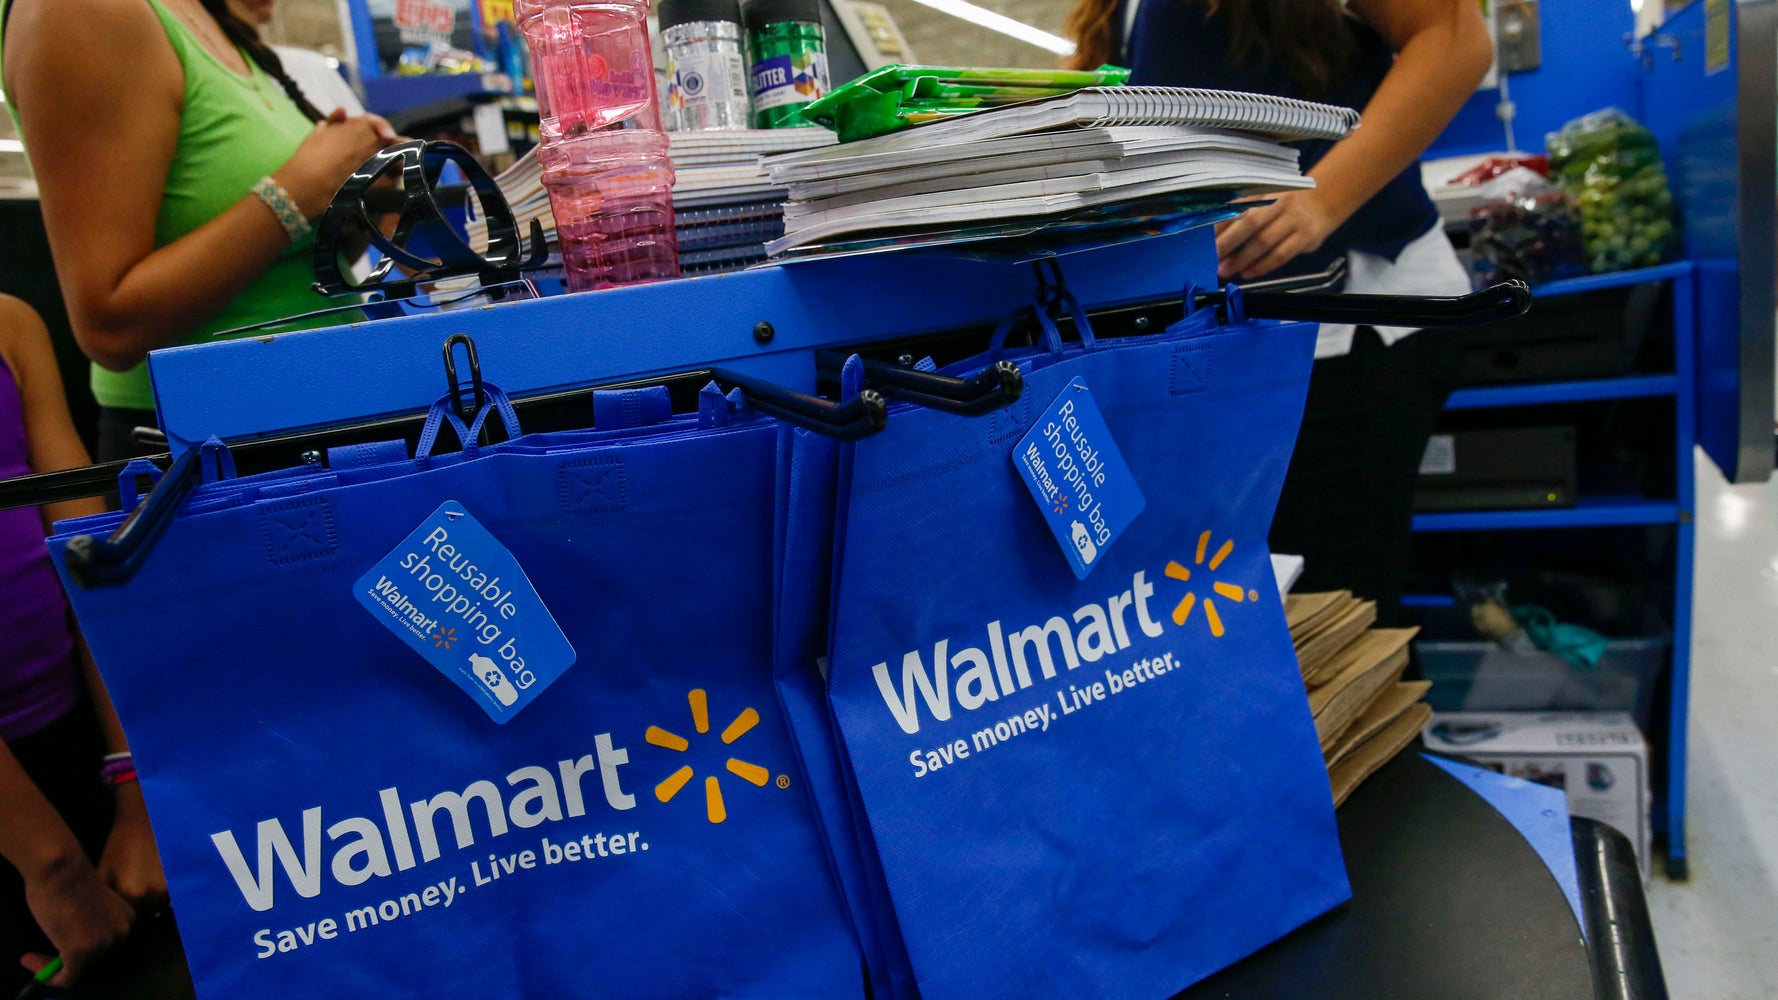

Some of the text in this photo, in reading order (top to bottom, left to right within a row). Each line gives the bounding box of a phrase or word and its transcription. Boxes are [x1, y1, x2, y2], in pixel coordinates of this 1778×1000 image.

[1026, 441, 1059, 499] Walmart
[1043, 421, 1094, 512] shopping
[1088, 502, 1111, 547] bag
[1058, 399, 1105, 488] Reusable
[367, 588, 427, 641] Save money. Live better.
[375, 575, 438, 635] Walmart
[400, 552, 502, 645] shopping
[497, 637, 537, 690] bag
[422, 526, 517, 620] Reusable
[872, 570, 1164, 735] Walmart
[909, 652, 1181, 778] Save money. Live better.
[210, 732, 637, 912] Walmart
[253, 831, 649, 959] Save money. Live better.
